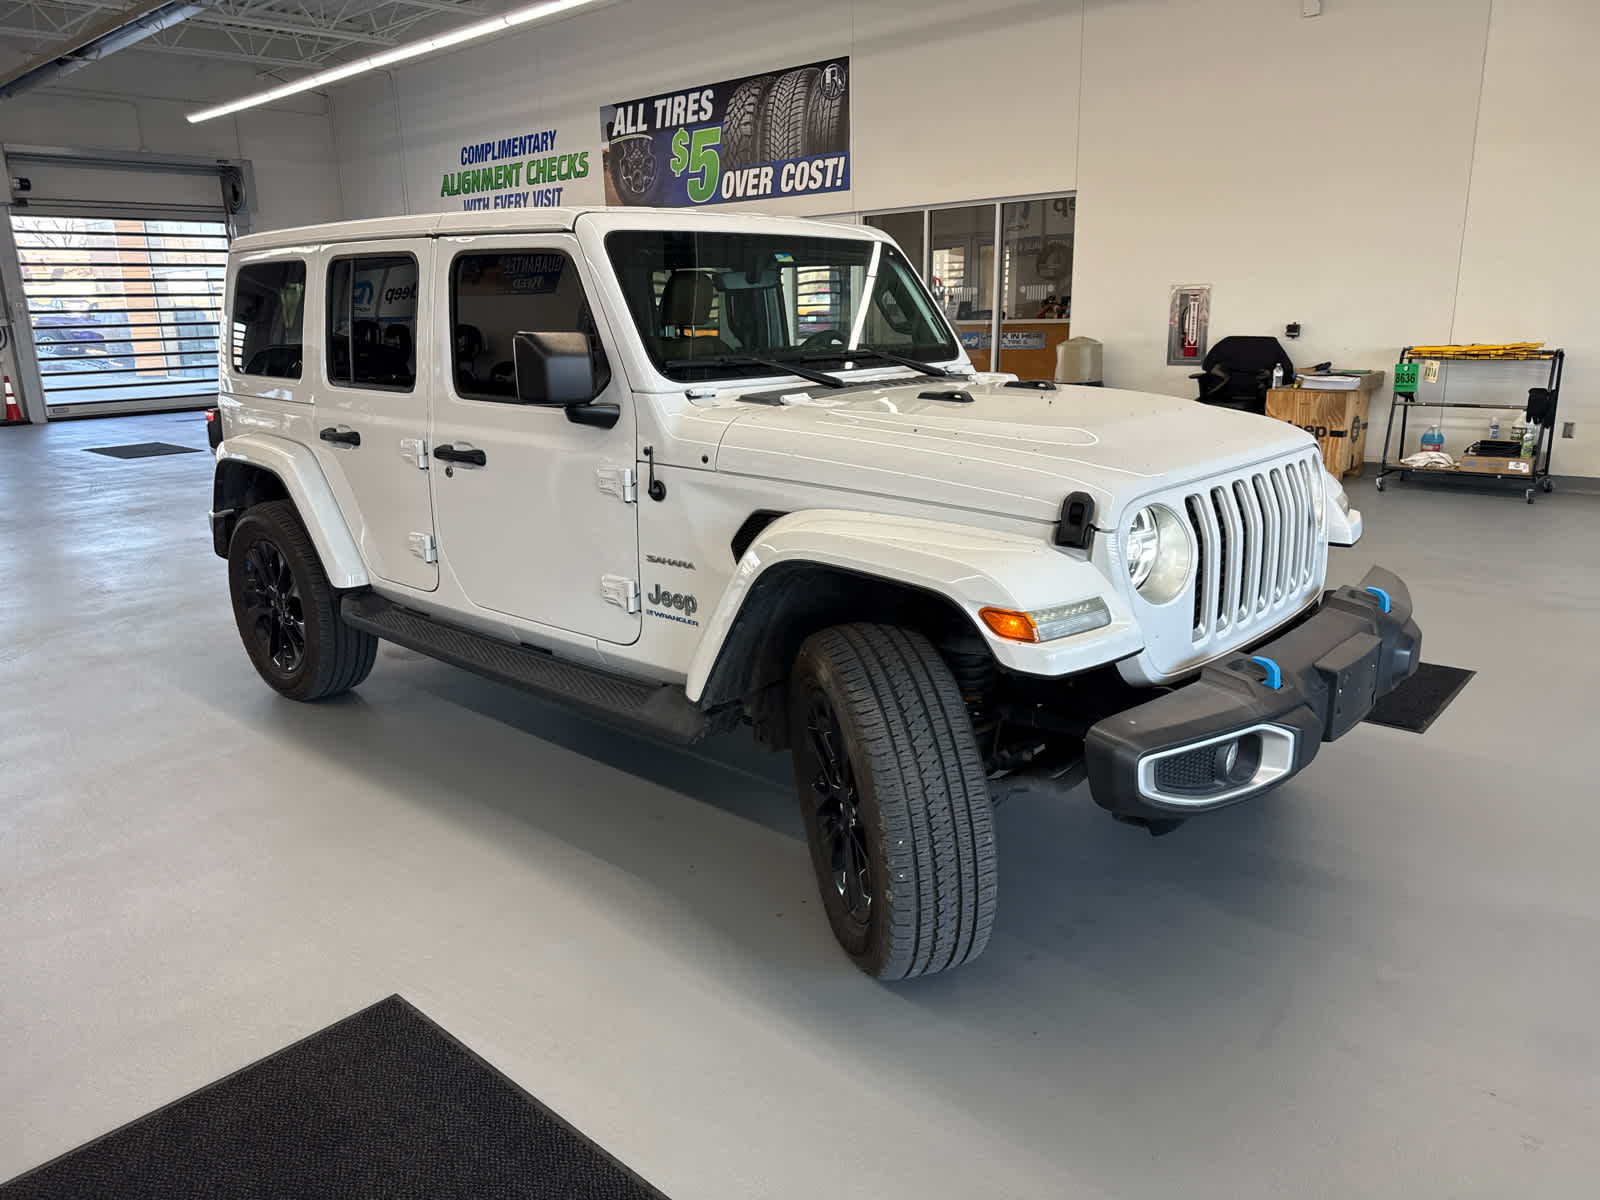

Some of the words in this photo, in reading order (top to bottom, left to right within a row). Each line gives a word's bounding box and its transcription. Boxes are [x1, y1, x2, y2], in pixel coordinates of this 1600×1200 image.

[612, 103, 648, 137] ALL
[654, 89, 714, 129] TIRES
[460, 129, 557, 166] COMPLIMENTARY
[670, 126, 722, 203] $5
[440, 161, 524, 197] ALIGNMENT
[526, 151, 589, 185] CHECKS
[721, 166, 774, 199] OVER
[780, 156, 846, 193] COST!
[463, 197, 490, 211] WITH
[494, 192, 529, 210] EVERY
[533, 187, 563, 207] VISIT
[646, 554, 697, 571] SAHARA
[648, 584, 697, 616] Jeep
